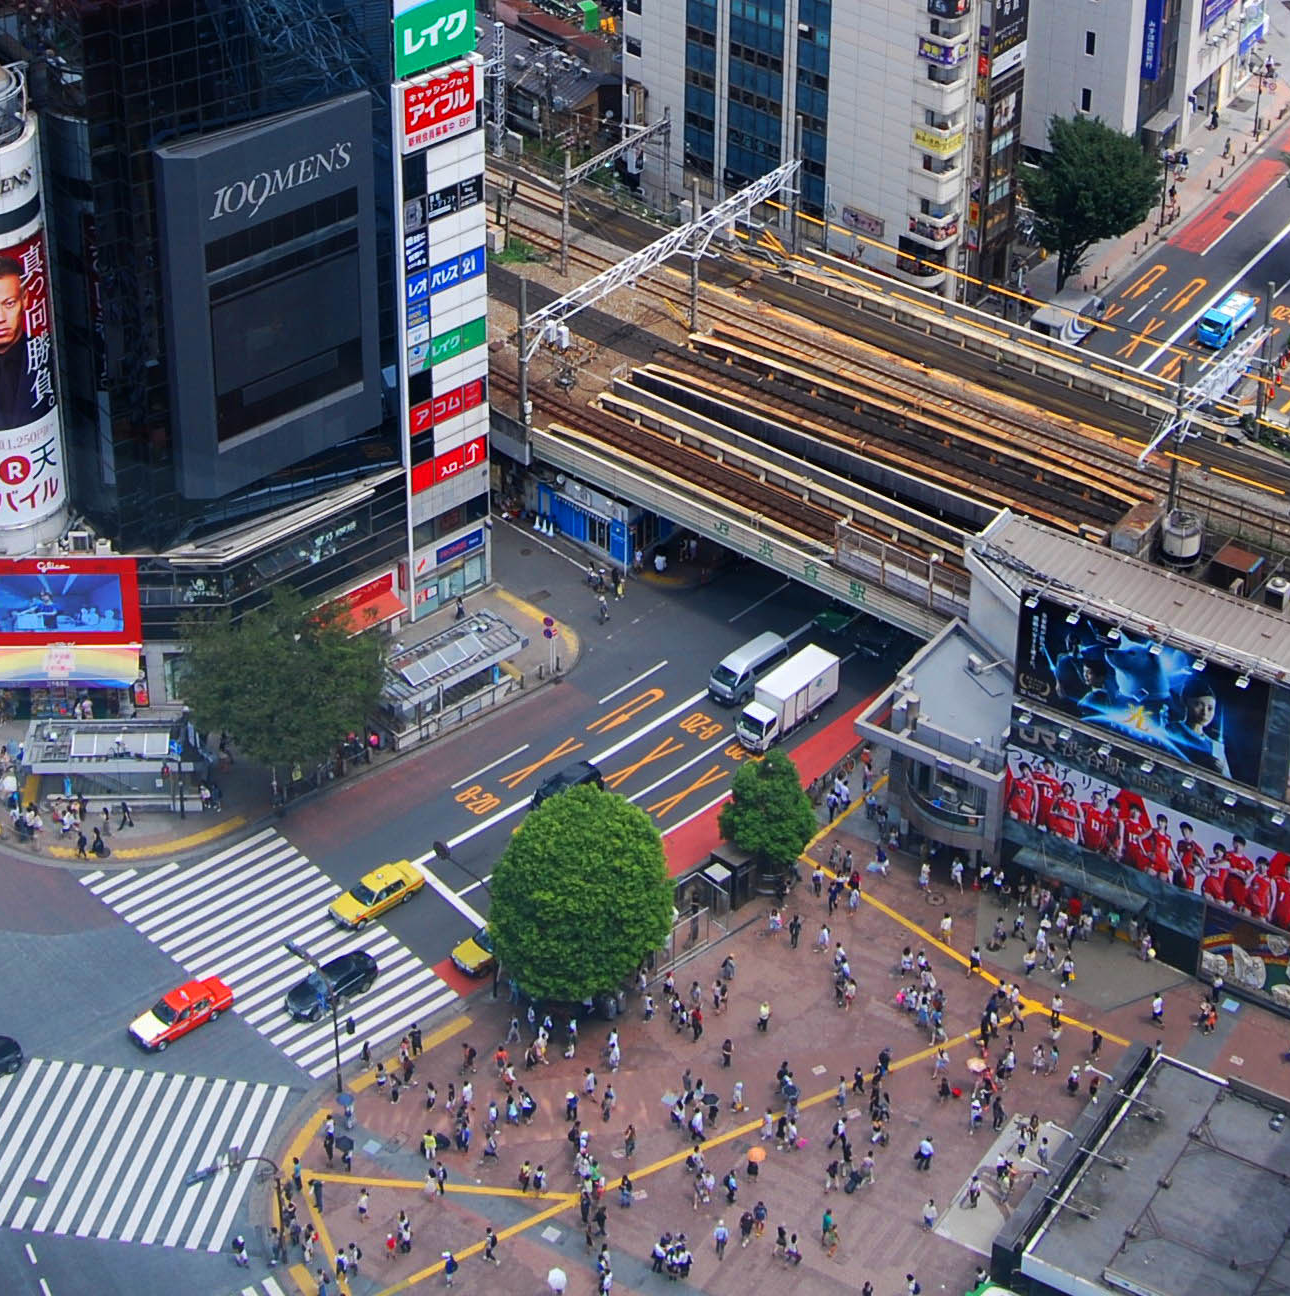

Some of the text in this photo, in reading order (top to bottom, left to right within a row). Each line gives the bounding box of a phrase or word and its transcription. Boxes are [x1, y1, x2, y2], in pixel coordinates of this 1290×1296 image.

[403, 8, 468, 57] レイク
[408, 89, 471, 126] アイフル
[208, 141, 353, 221] 109MEN'S
[18, 243, 57, 411] 真っ向勝負。
[432, 336, 461, 356] レイク
[416, 395, 461, 427] アコム
[36, 560, 71, 574] Glico
[678, 711, 724, 741] 8-20
[454, 784, 502, 816] 8-20
